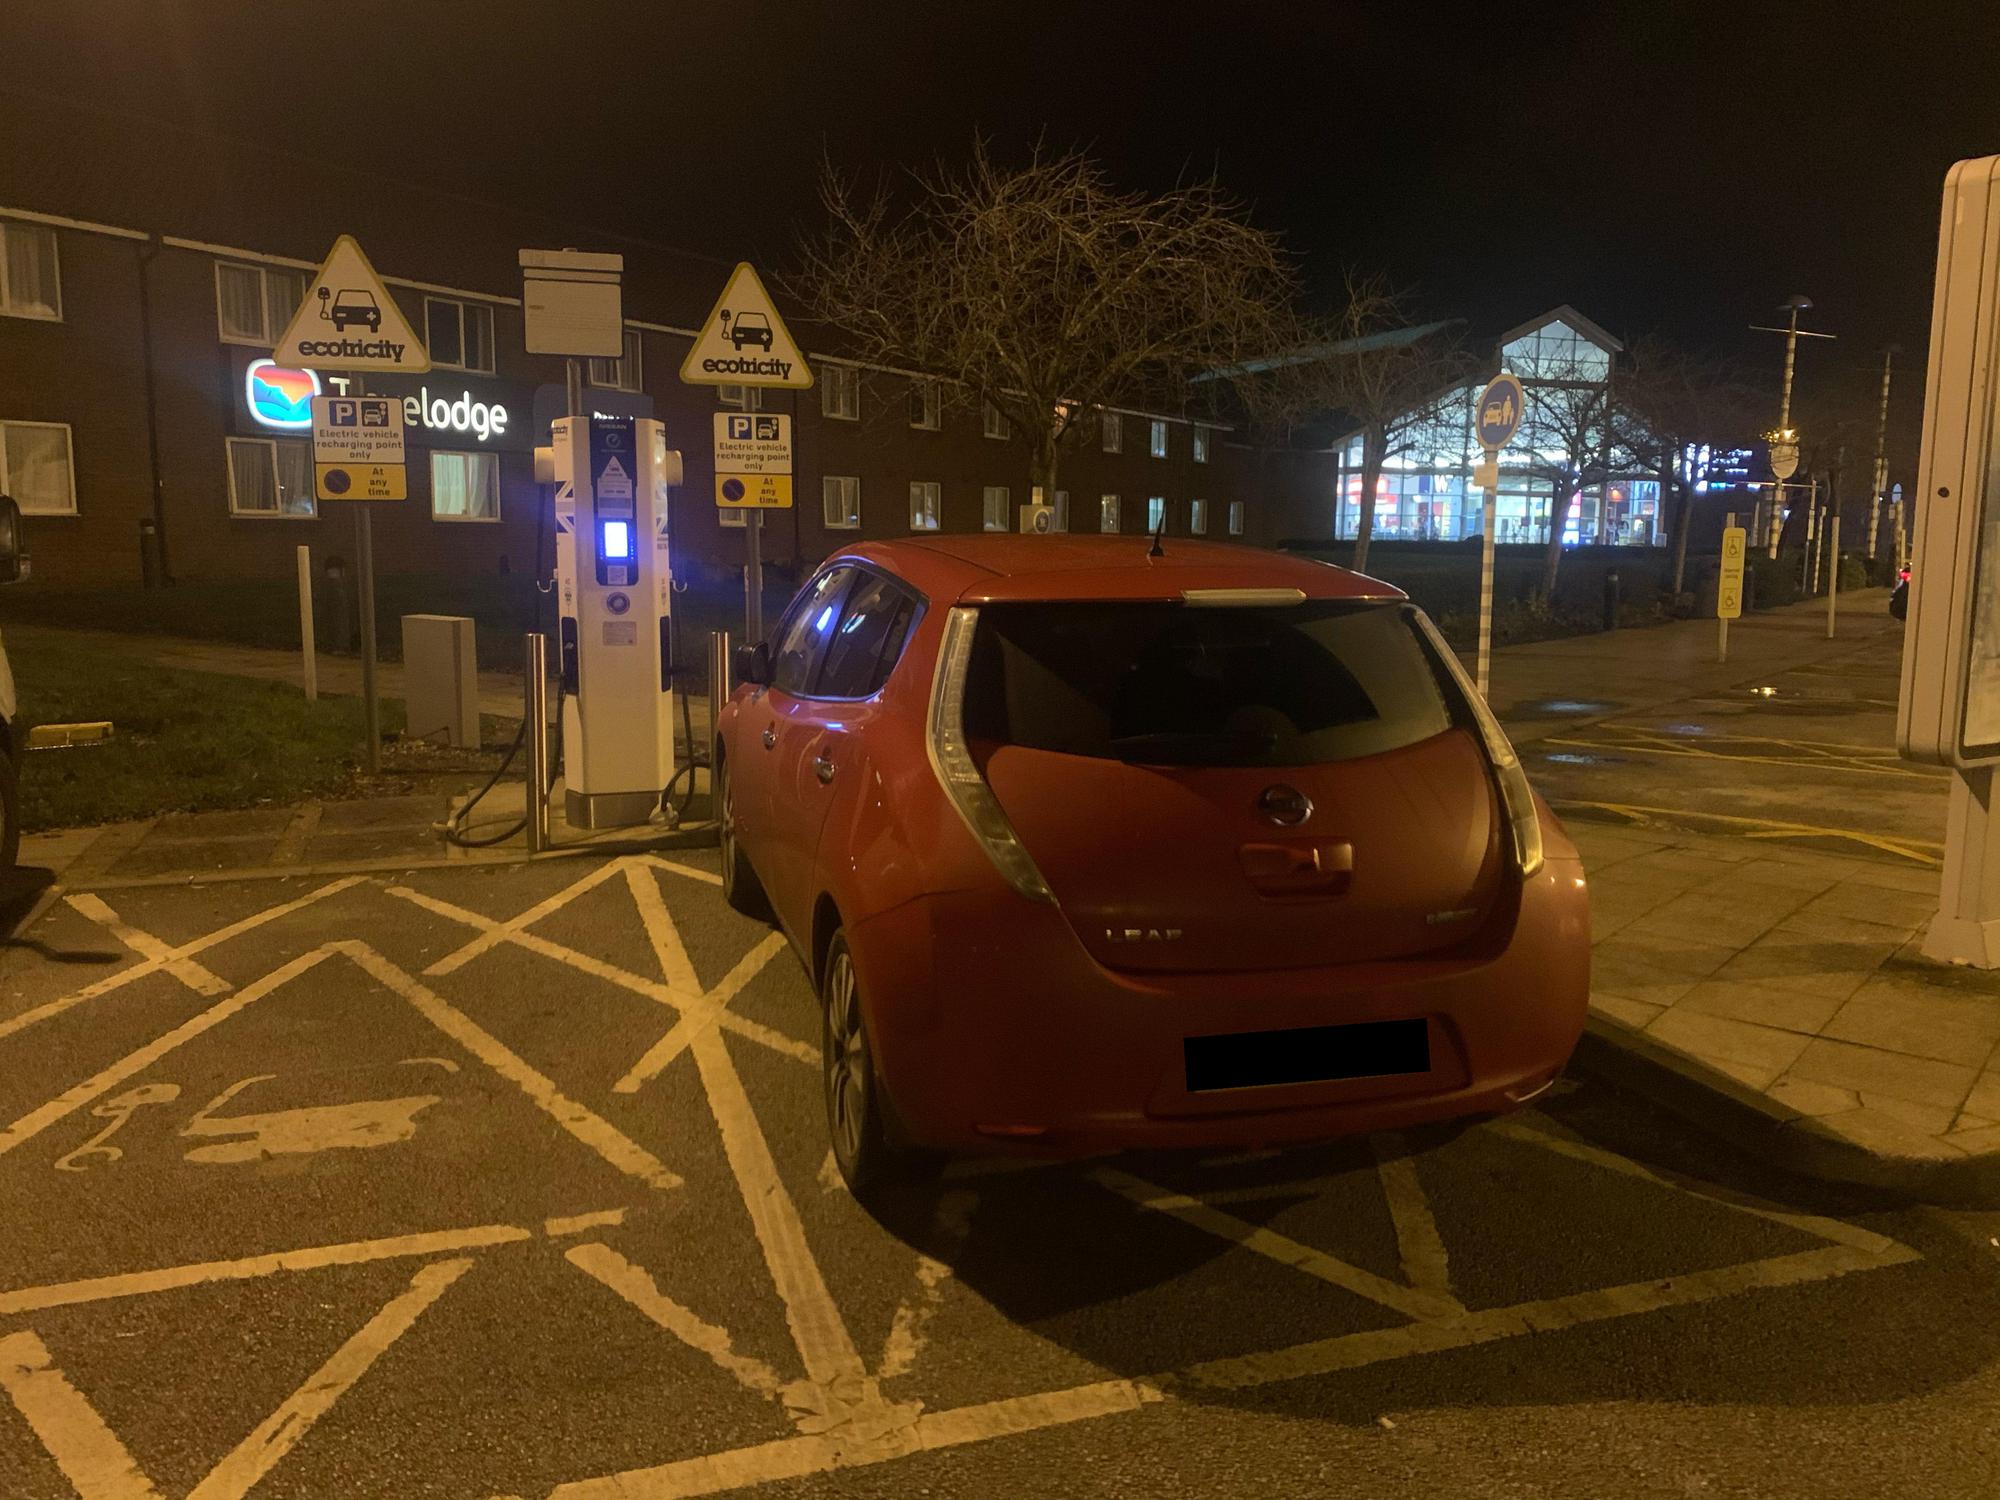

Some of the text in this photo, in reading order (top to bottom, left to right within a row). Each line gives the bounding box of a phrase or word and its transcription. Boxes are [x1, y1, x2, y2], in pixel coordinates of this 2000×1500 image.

[298, 338, 405, 363] ecotricity
[702, 356, 792, 380] ecotricity
[328, 377, 508, 442] Telodge
[319, 429, 399, 439] Electric vehicle
[317, 440, 402, 450] recharging point
[719, 442, 787, 452] Electric vehicle
[349, 451, 371, 460] only
[716, 453, 789, 462] recharging point
[744, 462, 763, 471] only
[372, 467, 384, 476] At
[369, 478, 387, 487] any
[763, 478, 774, 486] At
[367, 488, 390, 496] time
